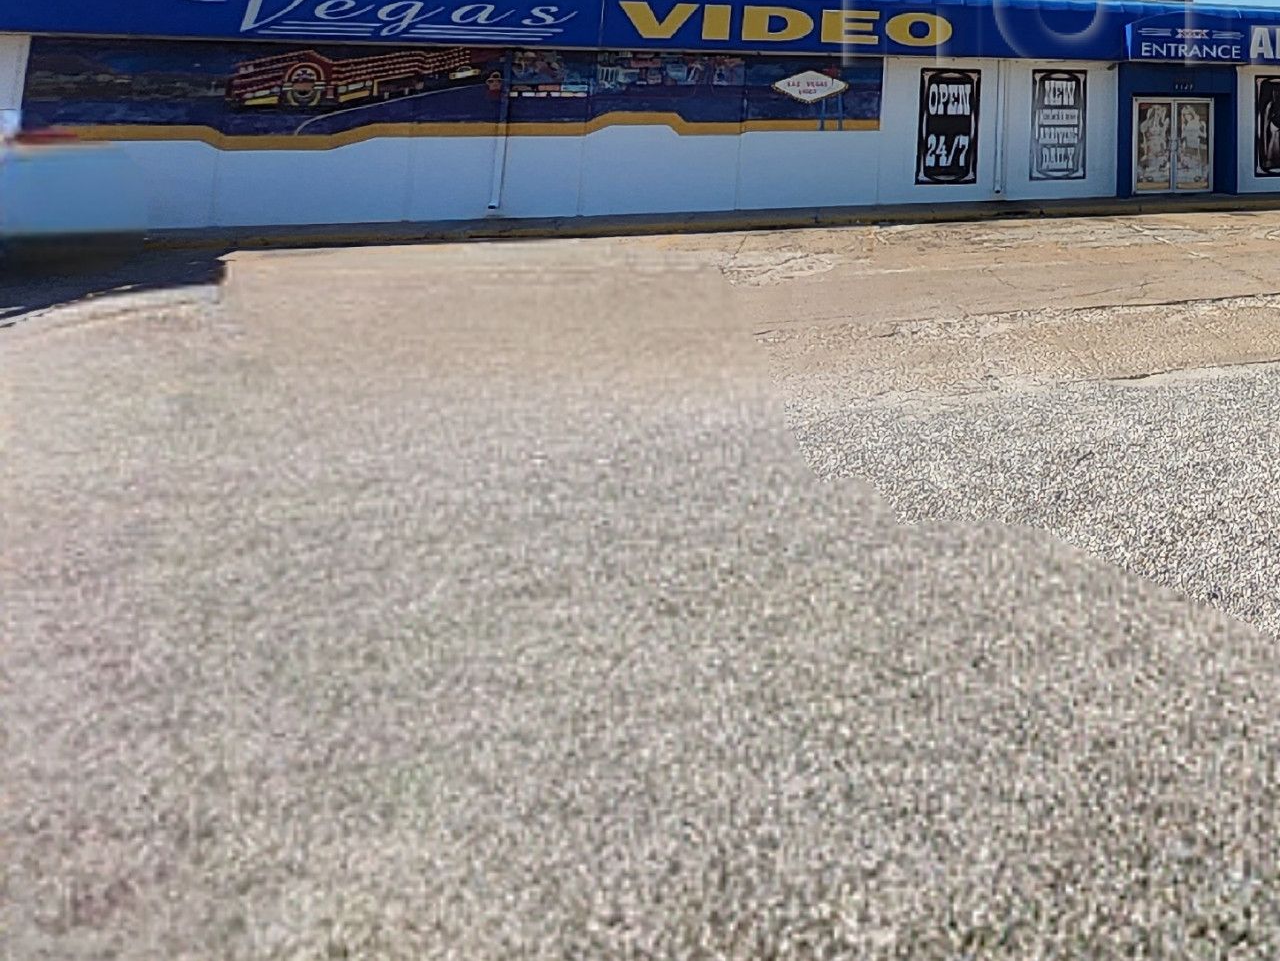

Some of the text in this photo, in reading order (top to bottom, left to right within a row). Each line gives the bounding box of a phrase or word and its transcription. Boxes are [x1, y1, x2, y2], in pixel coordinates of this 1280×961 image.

[619, 0, 953, 48] VIDEO
[1141, 42, 1241, 59] ENTRANCE
[929, 83, 972, 116] OPEN
[925, 133, 969, 167] 24/7
